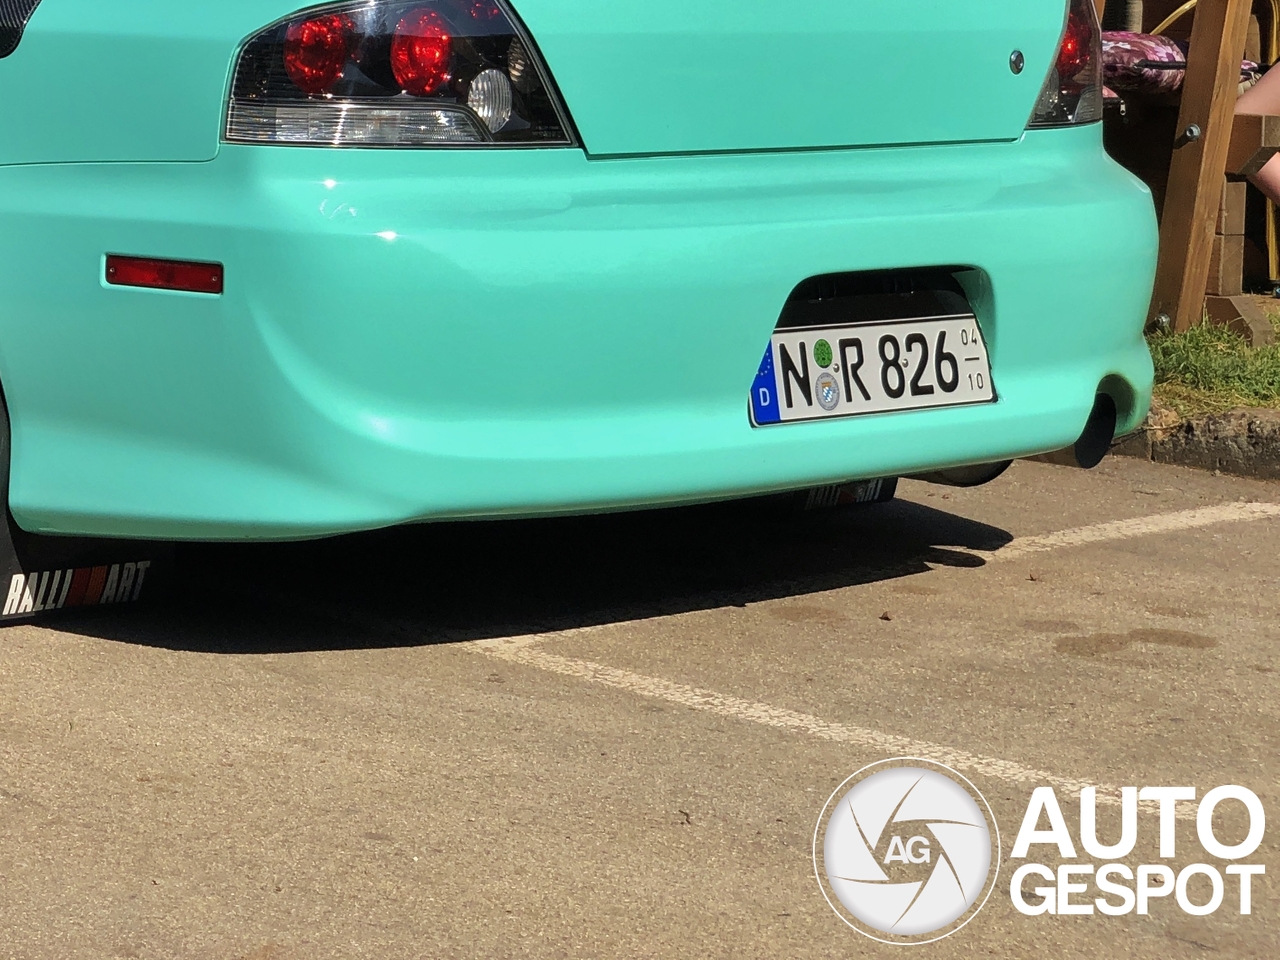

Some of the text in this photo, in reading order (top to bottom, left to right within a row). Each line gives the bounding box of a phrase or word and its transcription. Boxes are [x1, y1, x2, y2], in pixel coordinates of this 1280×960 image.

[960, 328, 978, 346] 04
[878, 330, 960, 399] 826
[967, 372, 984, 391] 10
[758, 387, 770, 407] D
